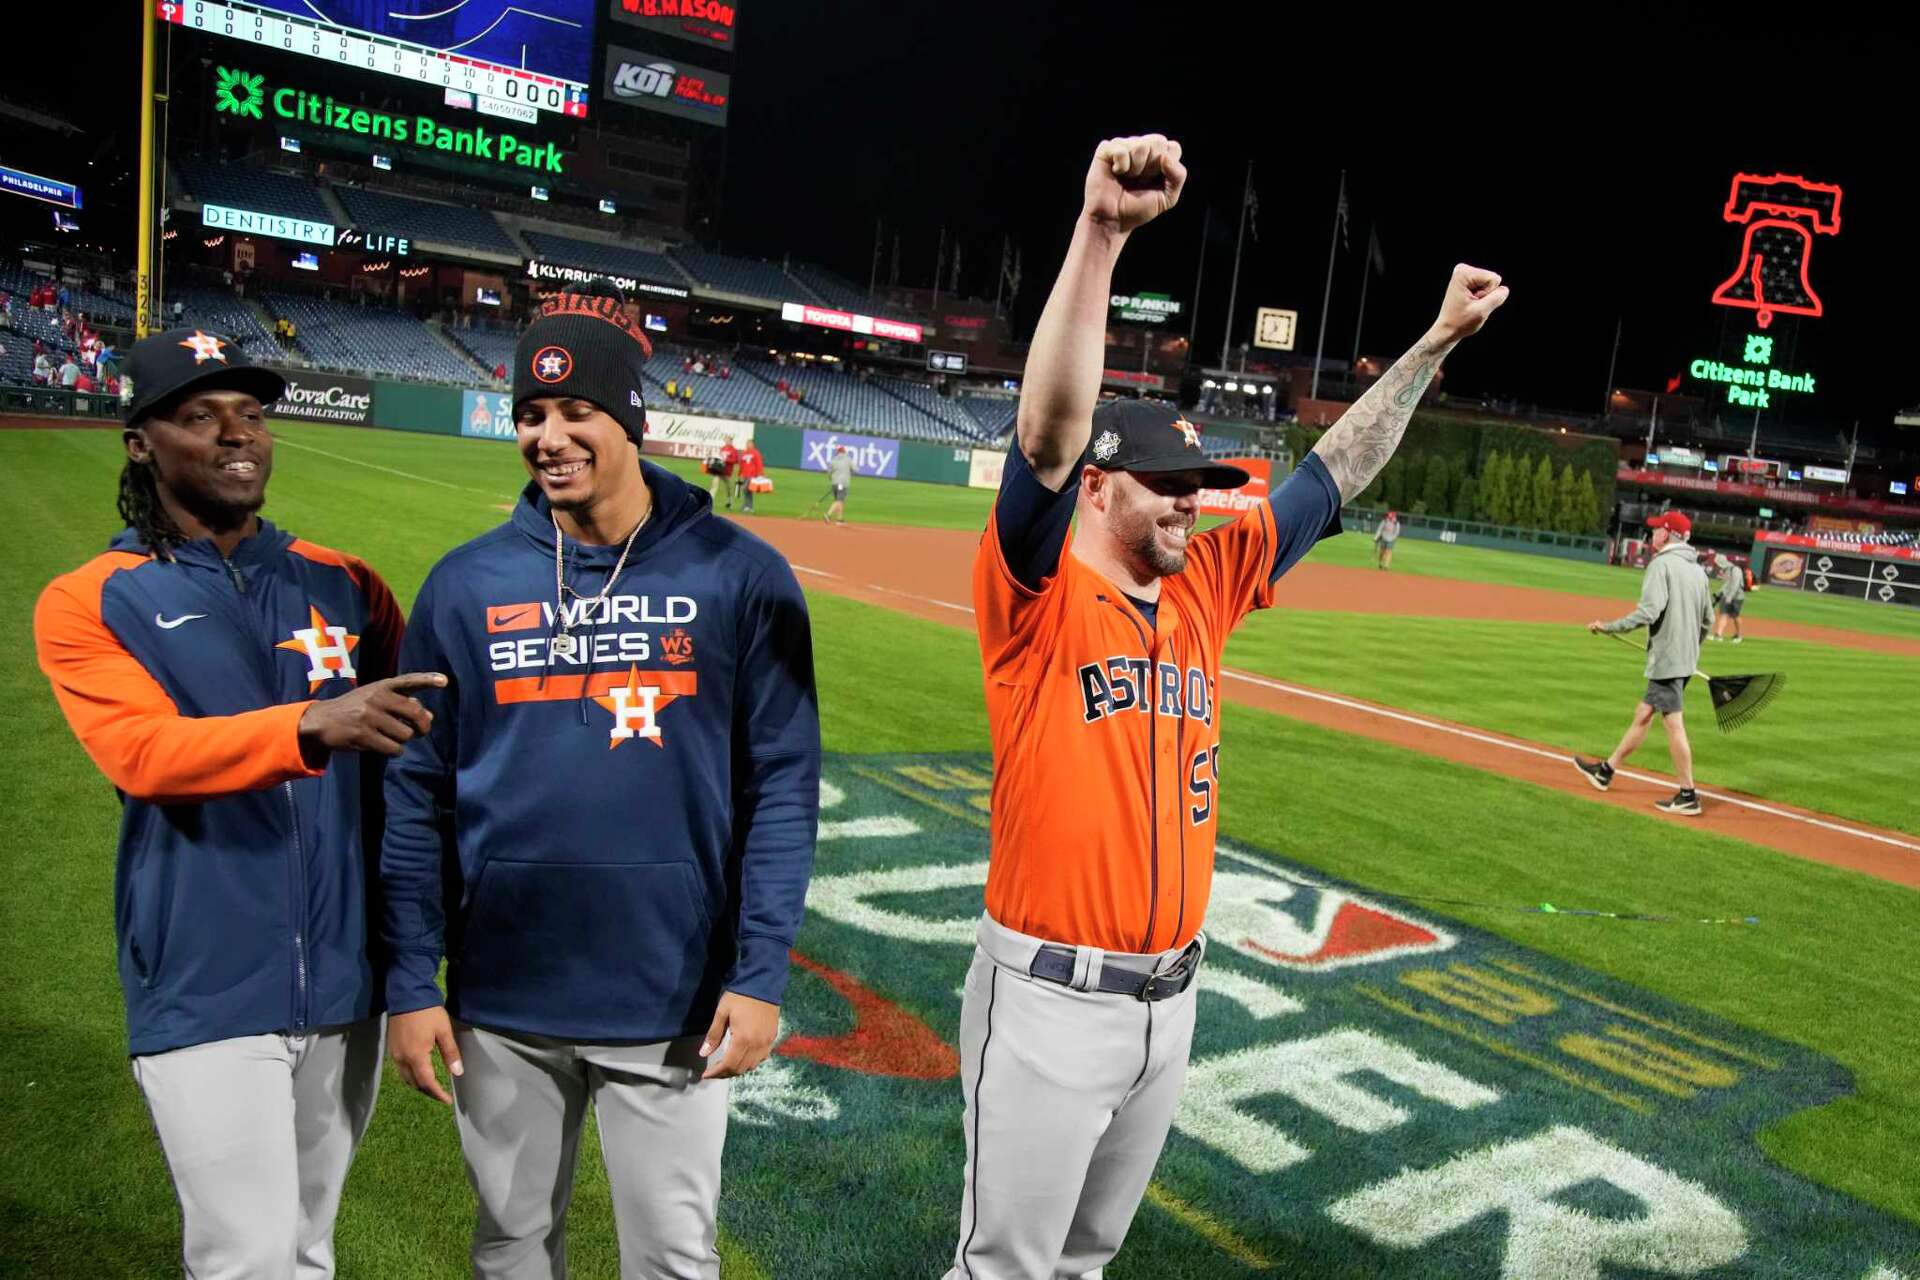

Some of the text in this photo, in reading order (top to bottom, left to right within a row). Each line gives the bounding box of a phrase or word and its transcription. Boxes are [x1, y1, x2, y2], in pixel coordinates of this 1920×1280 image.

[313, 31, 320, 41] 5
[273, 87, 408, 141] Citizens
[415, 116, 494, 158] Bank
[499, 134, 564, 174] Park
[206, 207, 409, 256] DENTISTRY for LIFE
[539, 264, 637, 291] KLYRRUOM
[805, 309, 851, 329] TOYOTA
[873, 320, 919, 339] TOYOTA
[1691, 359, 1816, 394] Citizens Bank
[1728, 384, 1770, 408] Park
[807, 435, 894, 476] xfnity
[541, 595, 698, 627] WORLD
[489, 632, 650, 671] SERIES
